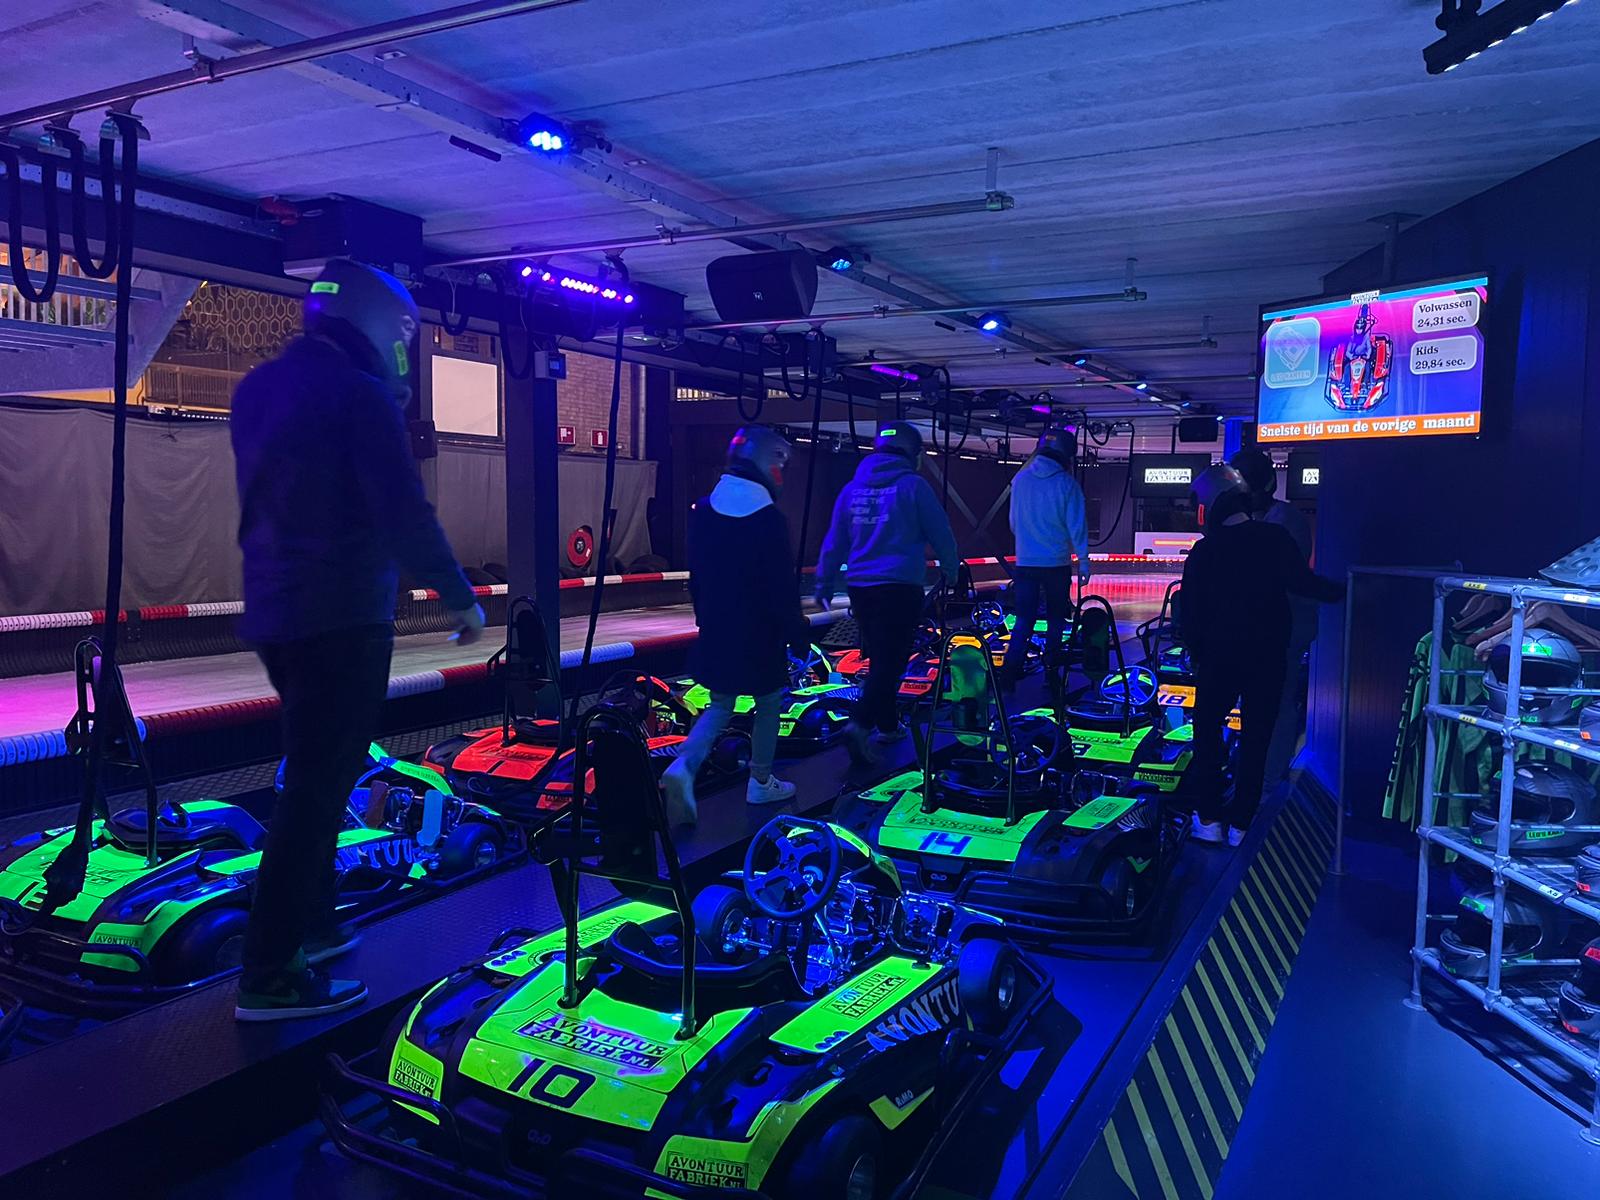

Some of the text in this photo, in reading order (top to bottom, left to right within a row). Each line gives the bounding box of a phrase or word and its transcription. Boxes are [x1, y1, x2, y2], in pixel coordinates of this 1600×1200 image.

[1419, 300, 1472, 313] Volwassen
[1418, 315, 1466, 328] 24,31 sec.
[1416, 346, 1439, 356] Kids
[1415, 358, 1466, 370] 29,84 sec.
[1260, 414, 1475, 437] Snelste tijd van de vorige maand
[918, 832, 973, 855] 14
[830, 973, 888, 1012] AVONTUUR
[521, 1022, 652, 1068] FABRIEK.NL
[540, 1012, 668, 1057] AVONTUUR
[397, 1060, 436, 1090] AVONTUUR
[507, 1057, 597, 1109] 10
[670, 1156, 744, 1177] AVONTUUR
